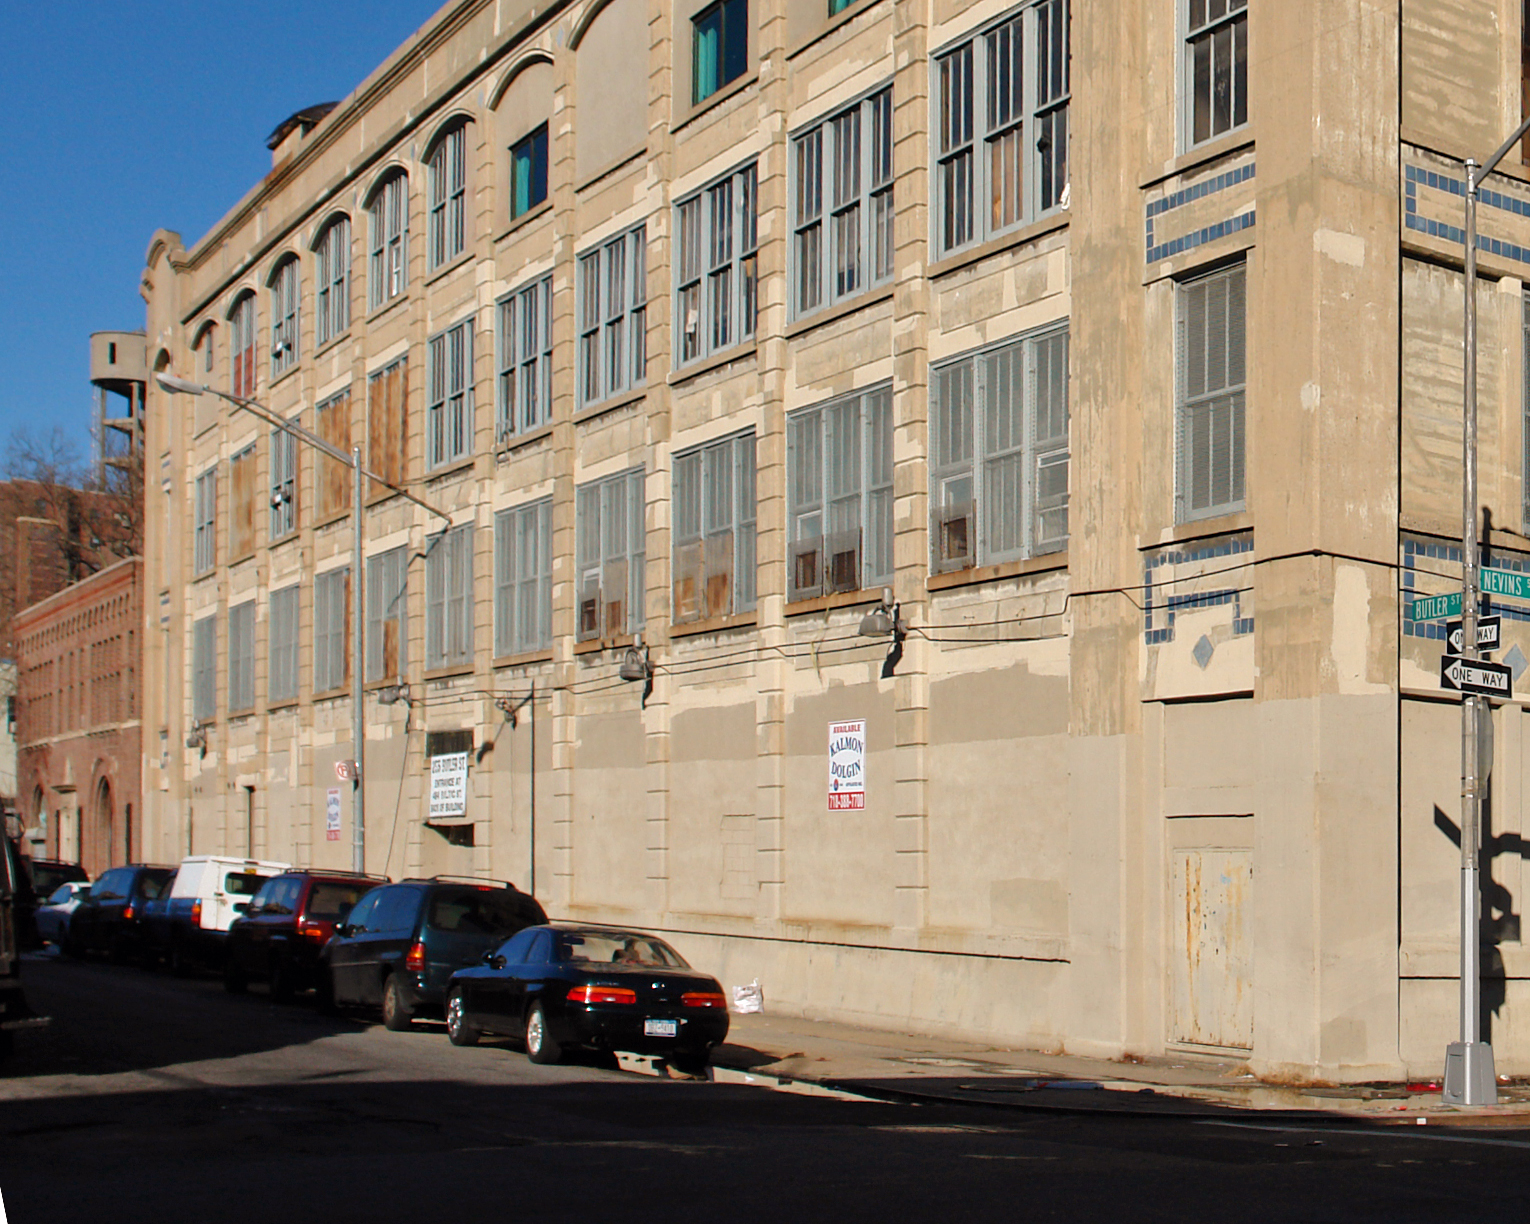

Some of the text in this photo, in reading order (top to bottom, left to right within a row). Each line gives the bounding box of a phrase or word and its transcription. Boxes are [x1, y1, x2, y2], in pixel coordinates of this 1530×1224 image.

[1484, 571, 1521, 595] NEVINS
[1415, 594, 1461, 619] BUTLER ST
[1452, 667, 1503, 687] ONE WAY
[833, 724, 861, 733] AVAILABLE
[830, 736, 864, 757] KALMON
[831, 759, 861, 779] DOLGIN
